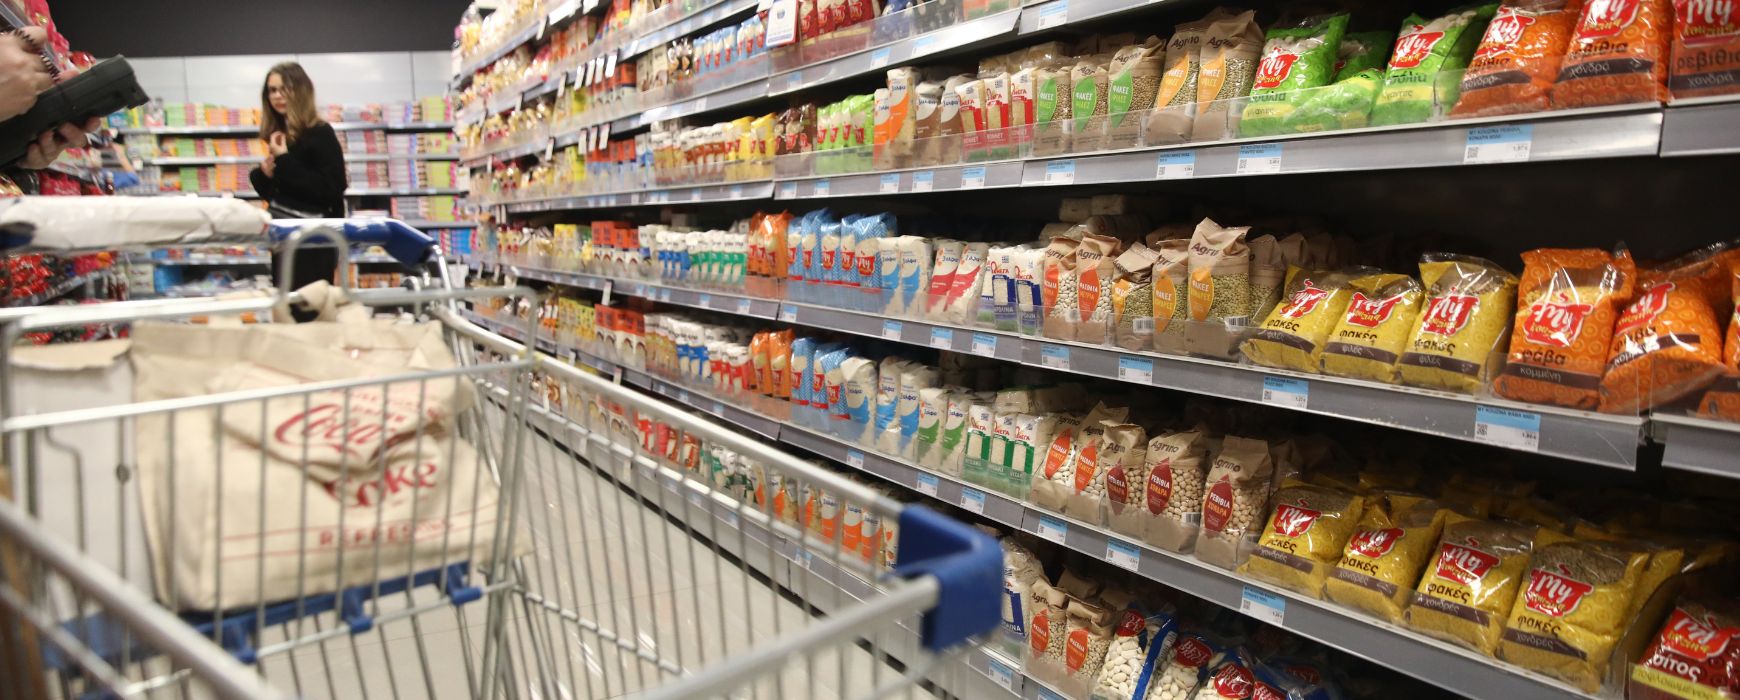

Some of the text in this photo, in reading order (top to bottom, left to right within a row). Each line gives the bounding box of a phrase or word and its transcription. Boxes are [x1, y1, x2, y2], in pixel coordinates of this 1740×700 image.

[1151, 440, 1180, 453] Agrino
[1427, 582, 1471, 604] φακές
[1535, 573, 1574, 604] My
[1518, 613, 1561, 638] φακές
